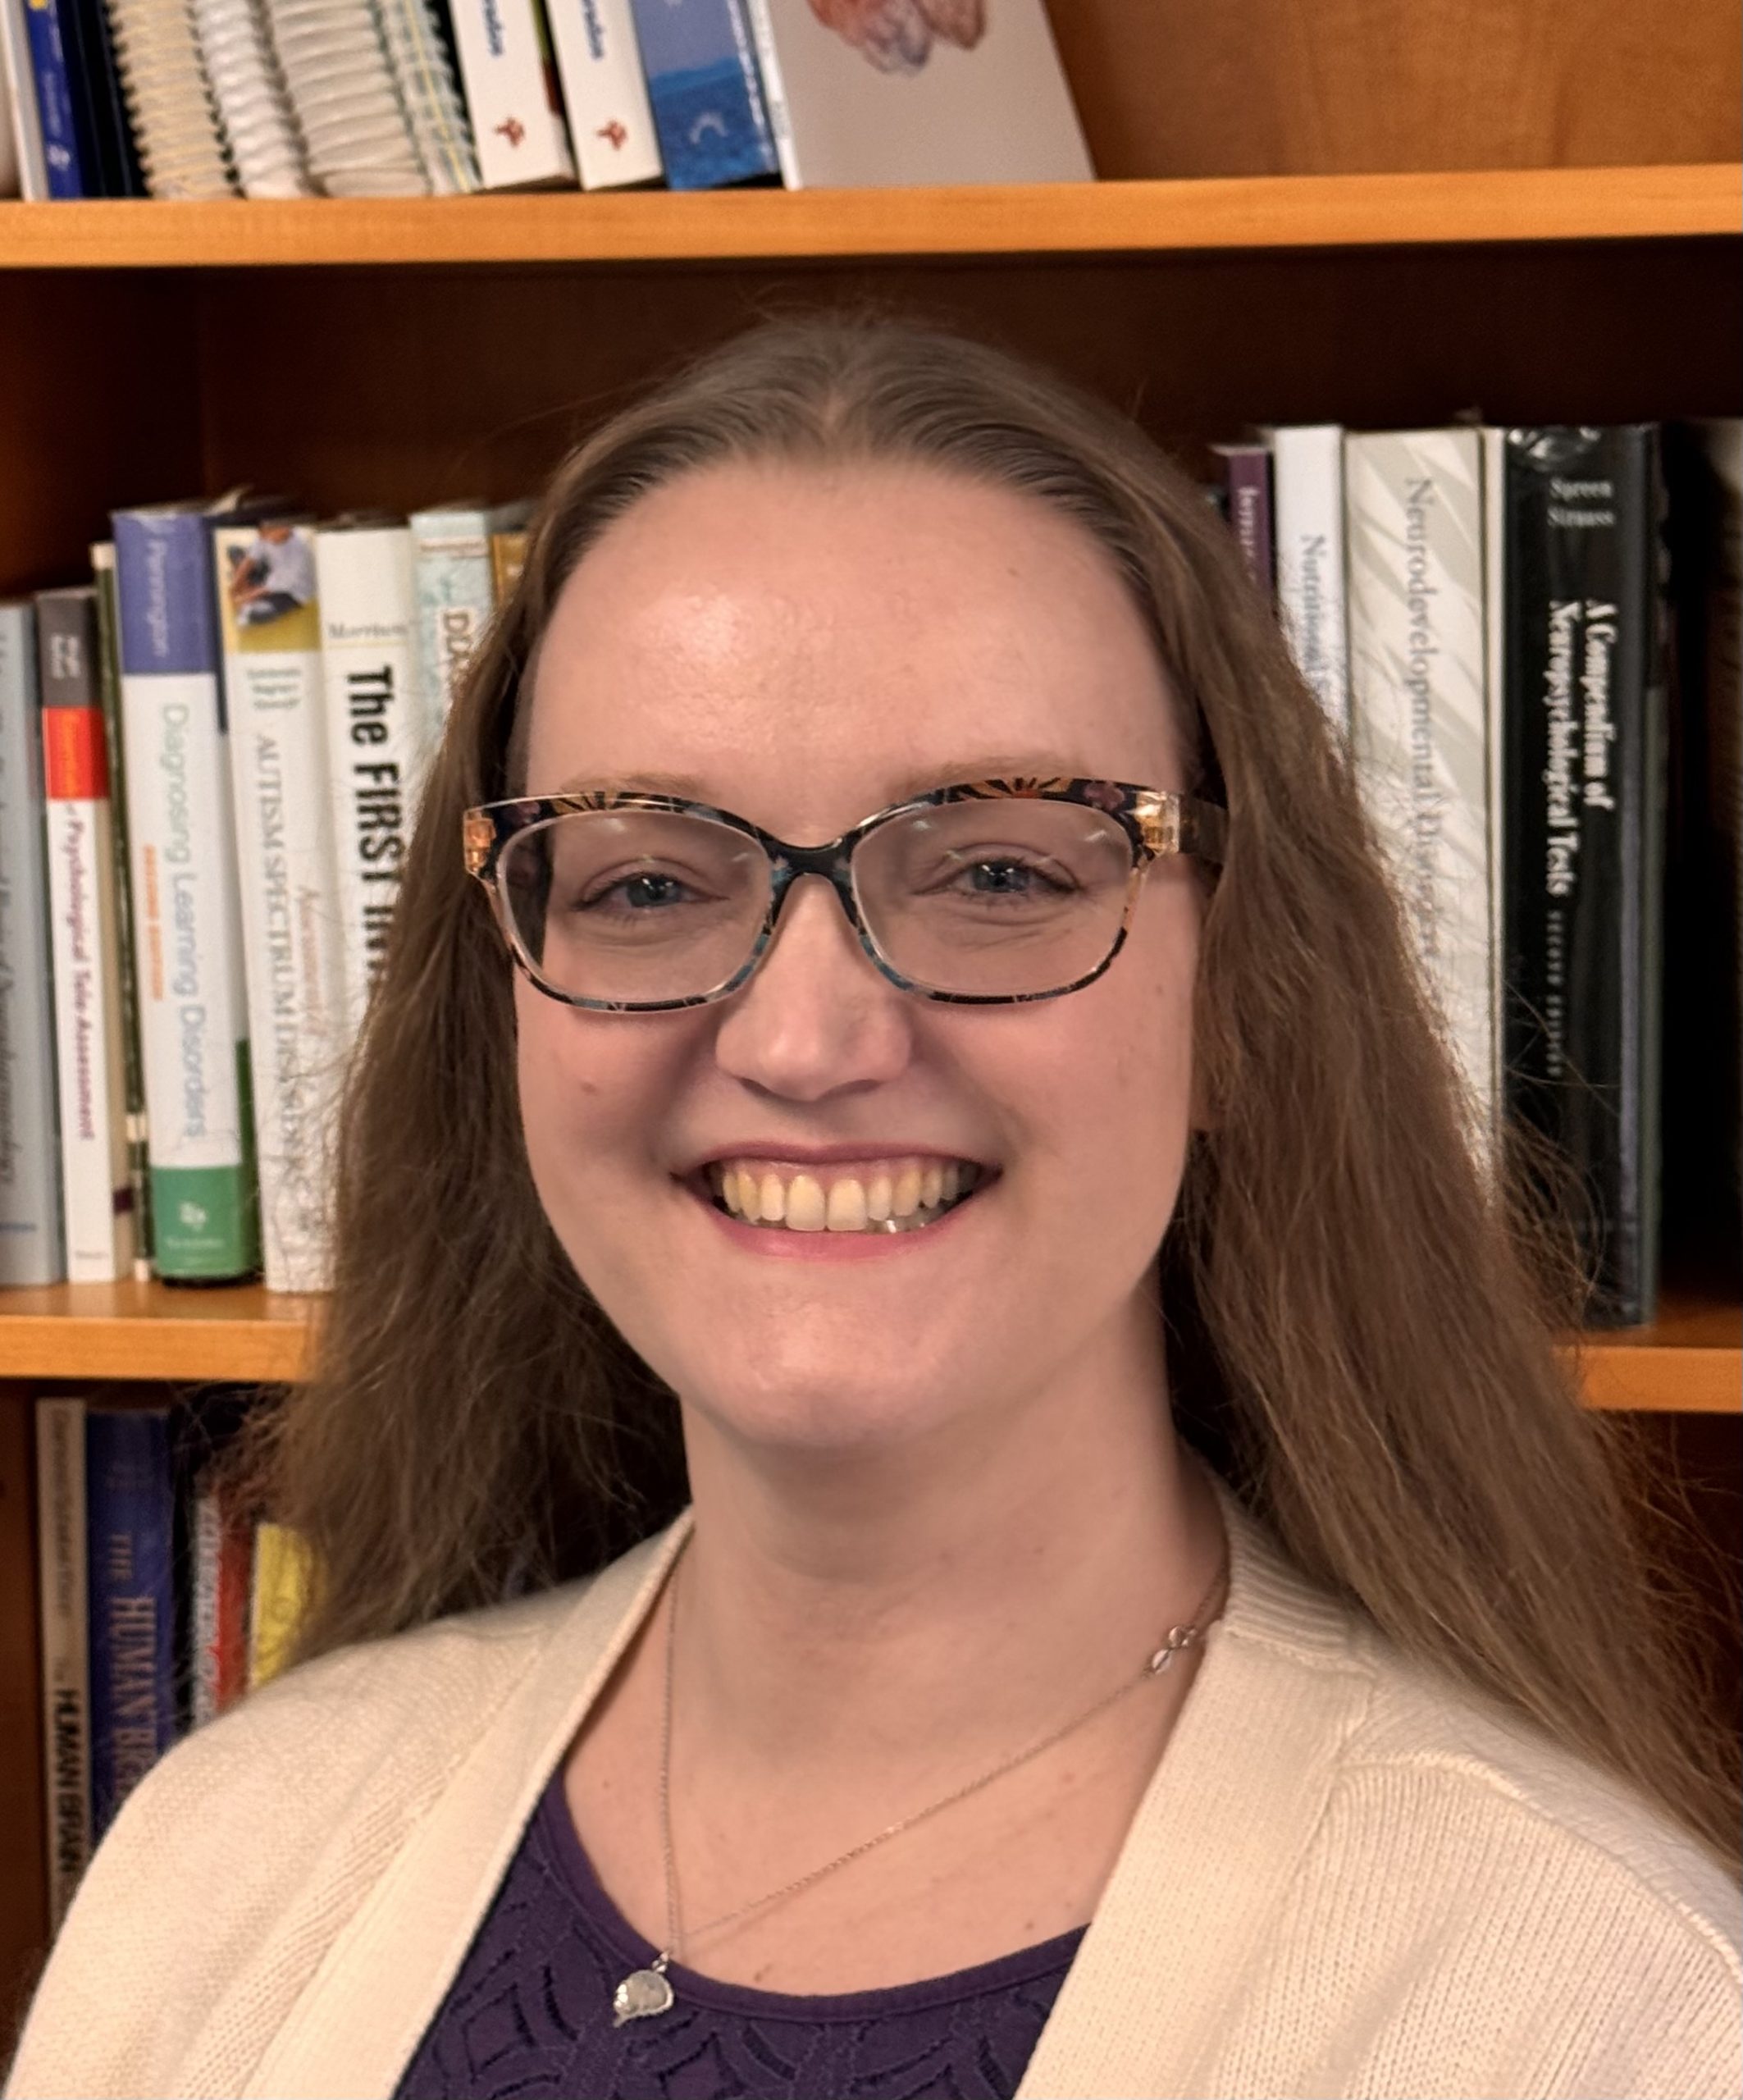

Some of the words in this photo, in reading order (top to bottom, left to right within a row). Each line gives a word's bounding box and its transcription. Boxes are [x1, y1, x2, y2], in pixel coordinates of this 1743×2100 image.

[1546, 504, 1616, 527] Strauss
[1549, 475, 1613, 501] Spreen
[145, 540, 171, 656] Pennington
[1403, 477, 1441, 801] Neurodevelopmental
[347, 665, 395, 746] The
[1543, 600, 1584, 827] Neuropsychological
[1581, 621, 1618, 780] Compendium
[160, 702, 192, 864] Diagnosing
[257, 734, 285, 849] AUTISM
[354, 763, 404, 882] FIRST
[1585, 783, 1616, 810] of
[62, 820, 90, 962] Psychological
[1545, 832, 1578, 897] Tests
[170, 874, 203, 998] Learning
[259, 854, 296, 1017] SPECTRUM
[180, 1004, 208, 1138] Disorders
[110, 1597, 157, 1719] HUMAN
[53, 1688, 80, 1787] HUMAN
[57, 1792, 82, 1874] BRAIN
